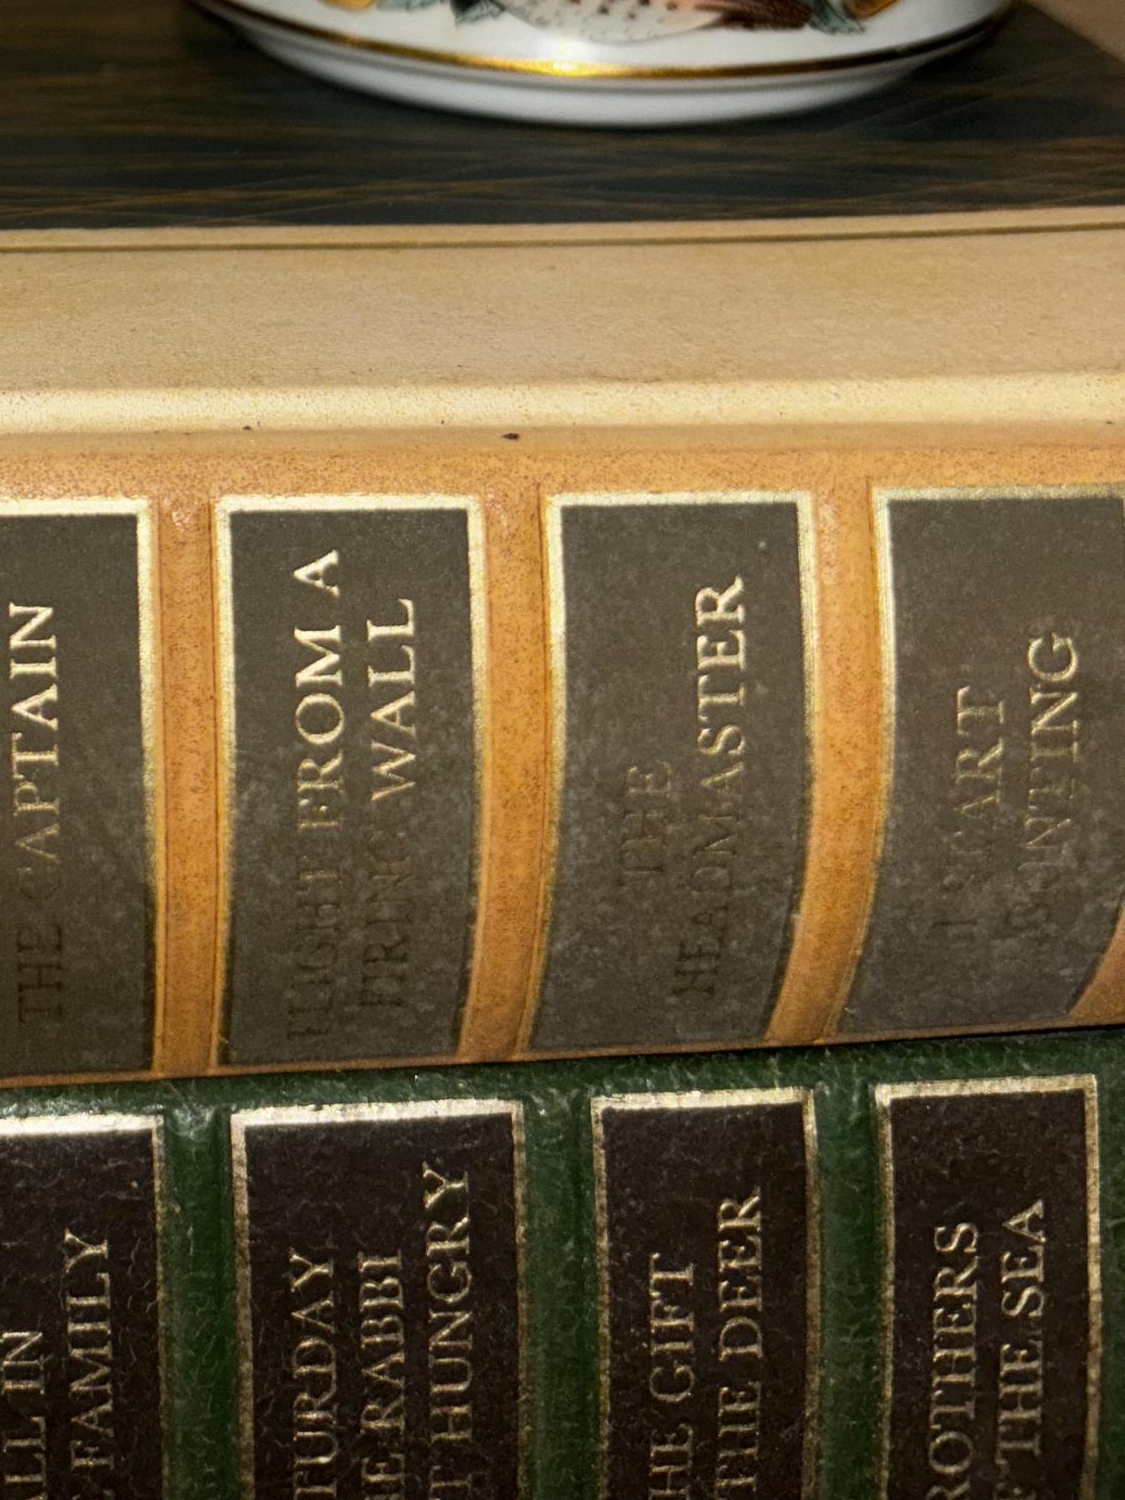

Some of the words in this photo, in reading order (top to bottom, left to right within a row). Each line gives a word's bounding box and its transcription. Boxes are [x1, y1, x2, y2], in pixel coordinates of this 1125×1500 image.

[291, 548, 342, 599] A
[292, 624, 347, 830] FROM
[365, 598, 418, 801] WALL
[617, 760, 673, 888] THE
[671, 574, 748, 998] HEADMASTER
[15, 922, 65, 1025] THE
[421, 1160, 475, 1443] HUNGRY
[647, 1251, 695, 1403] GIFT
[716, 1184, 764, 1362] DEER
[999, 1198, 1048, 1320] SEA
[62, 1227, 116, 1472] FAMILY
[355, 1248, 407, 1436] RABBI
[994, 1340, 1045, 1465] THE
[714, 1381, 762, 1500] THE
